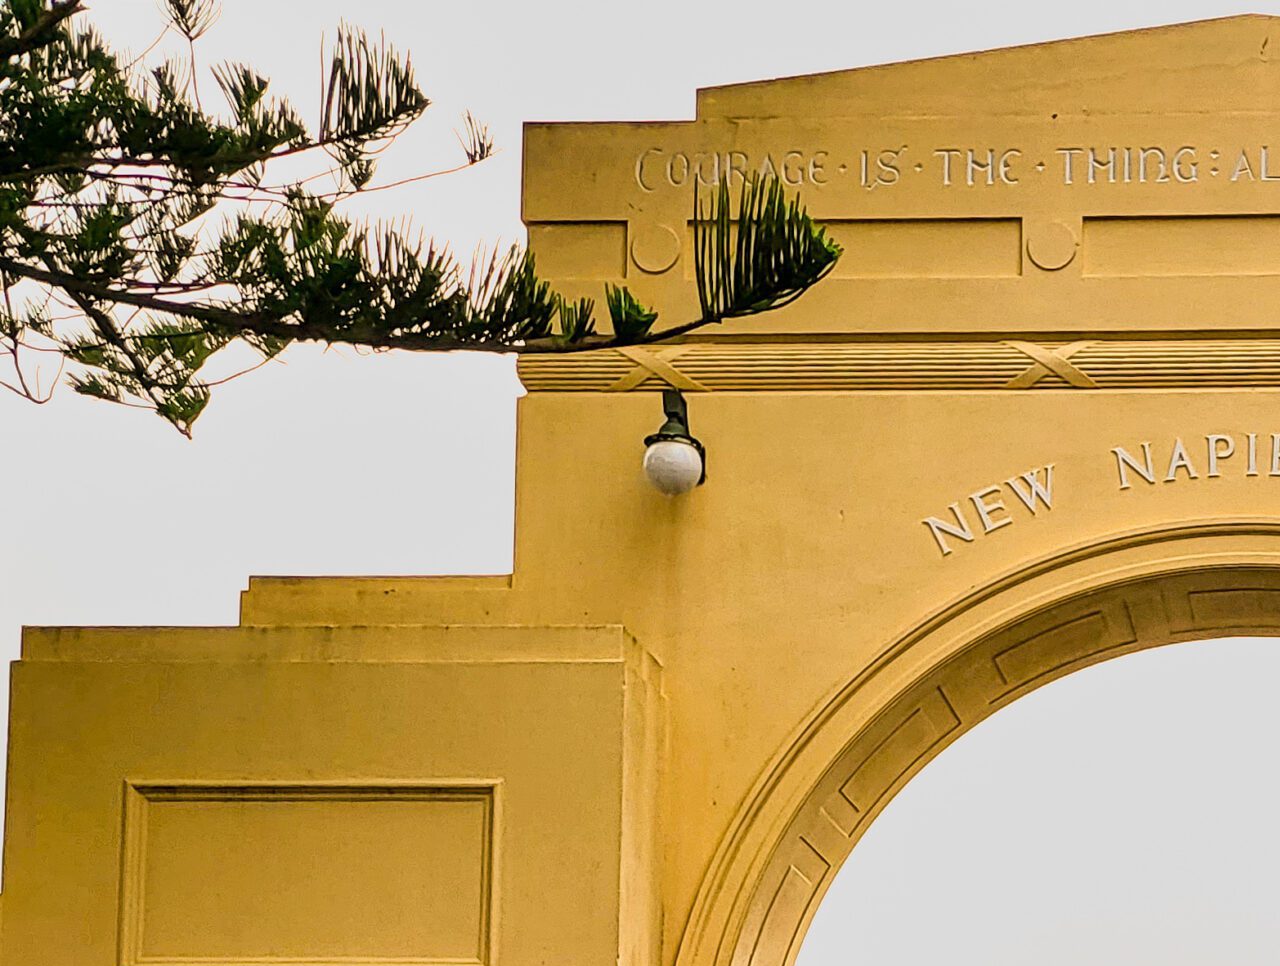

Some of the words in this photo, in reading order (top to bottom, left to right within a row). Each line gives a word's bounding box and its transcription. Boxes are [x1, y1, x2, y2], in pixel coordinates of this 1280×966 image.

[635, 148, 829, 193] COURAGE
[859, 145, 908, 190] IS
[932, 148, 1022, 186] THE
[920, 463, 1056, 556] NEW
